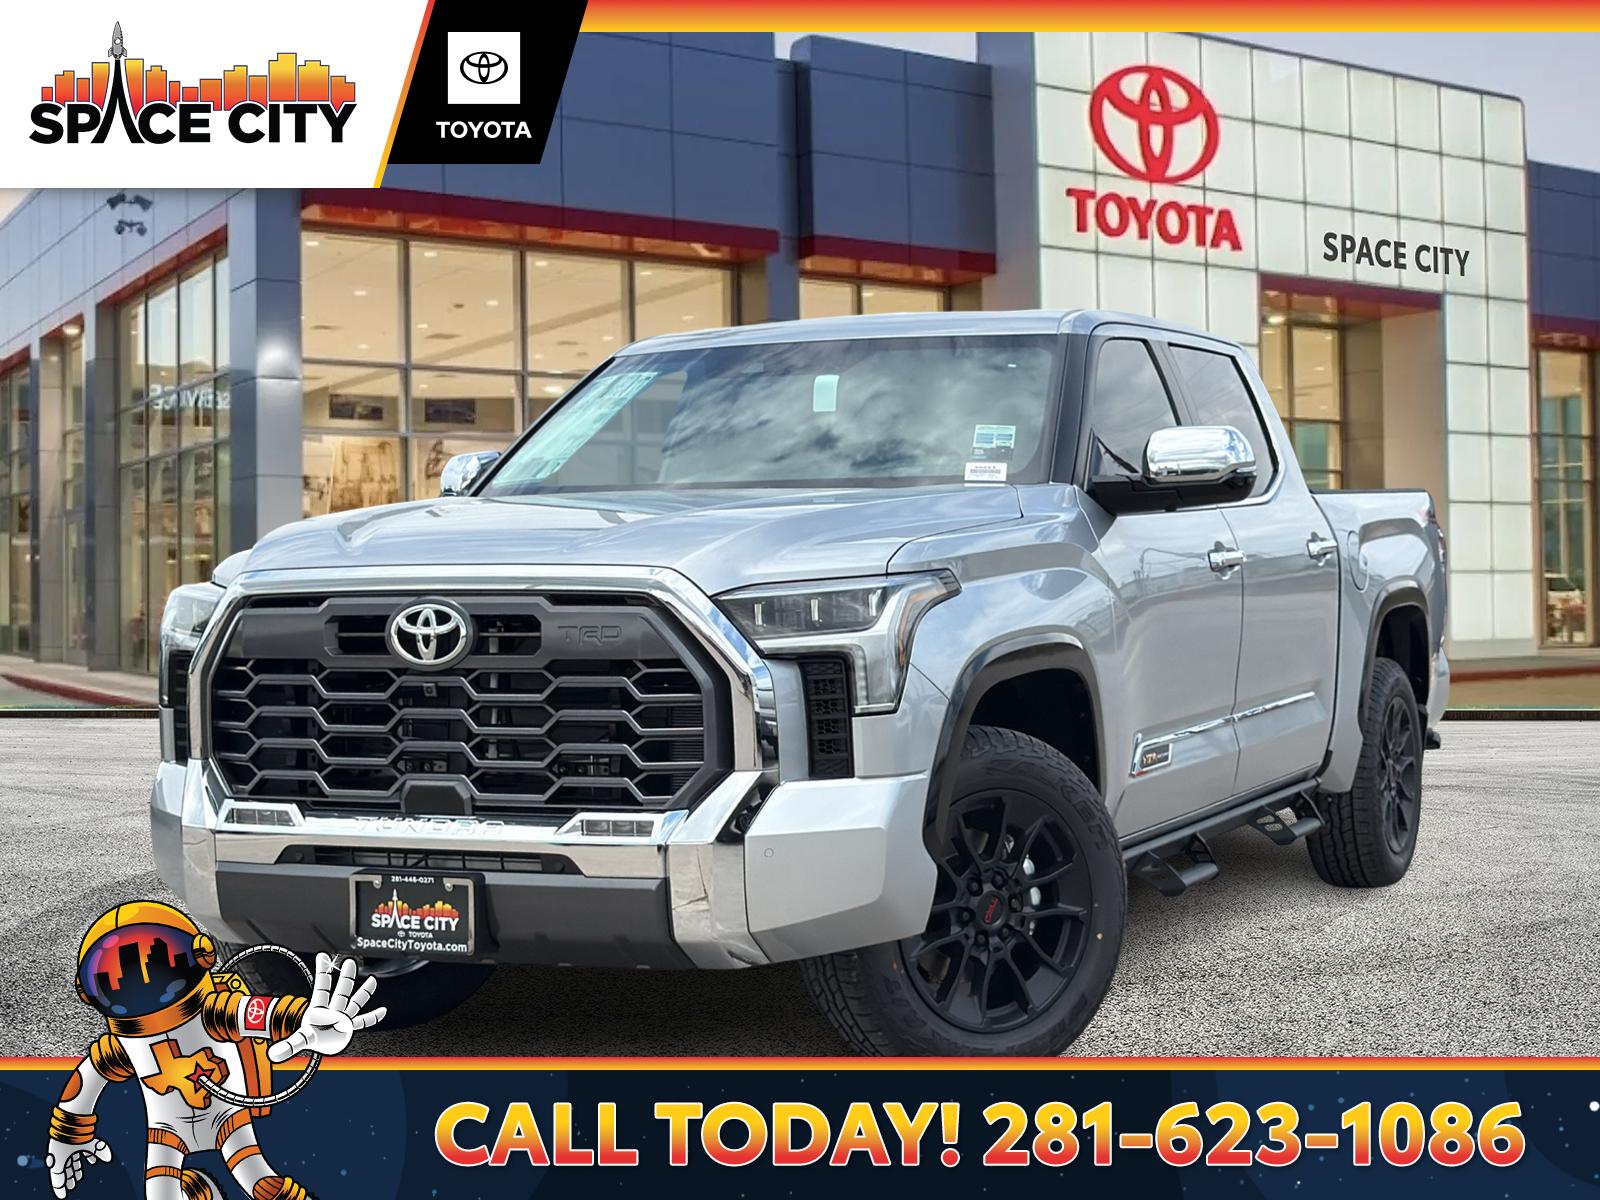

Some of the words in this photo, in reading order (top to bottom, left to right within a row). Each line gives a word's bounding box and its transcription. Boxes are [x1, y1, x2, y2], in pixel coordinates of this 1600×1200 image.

[1066, 188, 1242, 251] TOYOTA
[1323, 232, 1407, 270] SPACE
[1415, 244, 1470, 276] CITY
[557, 625, 622, 646] TRD
[371, 908, 421, 930] SPACE
[424, 916, 460, 932] CITY
[356, 936, 468, 953] SpaceCityToyota.com
[408, 931, 434, 939] TOYOTA
